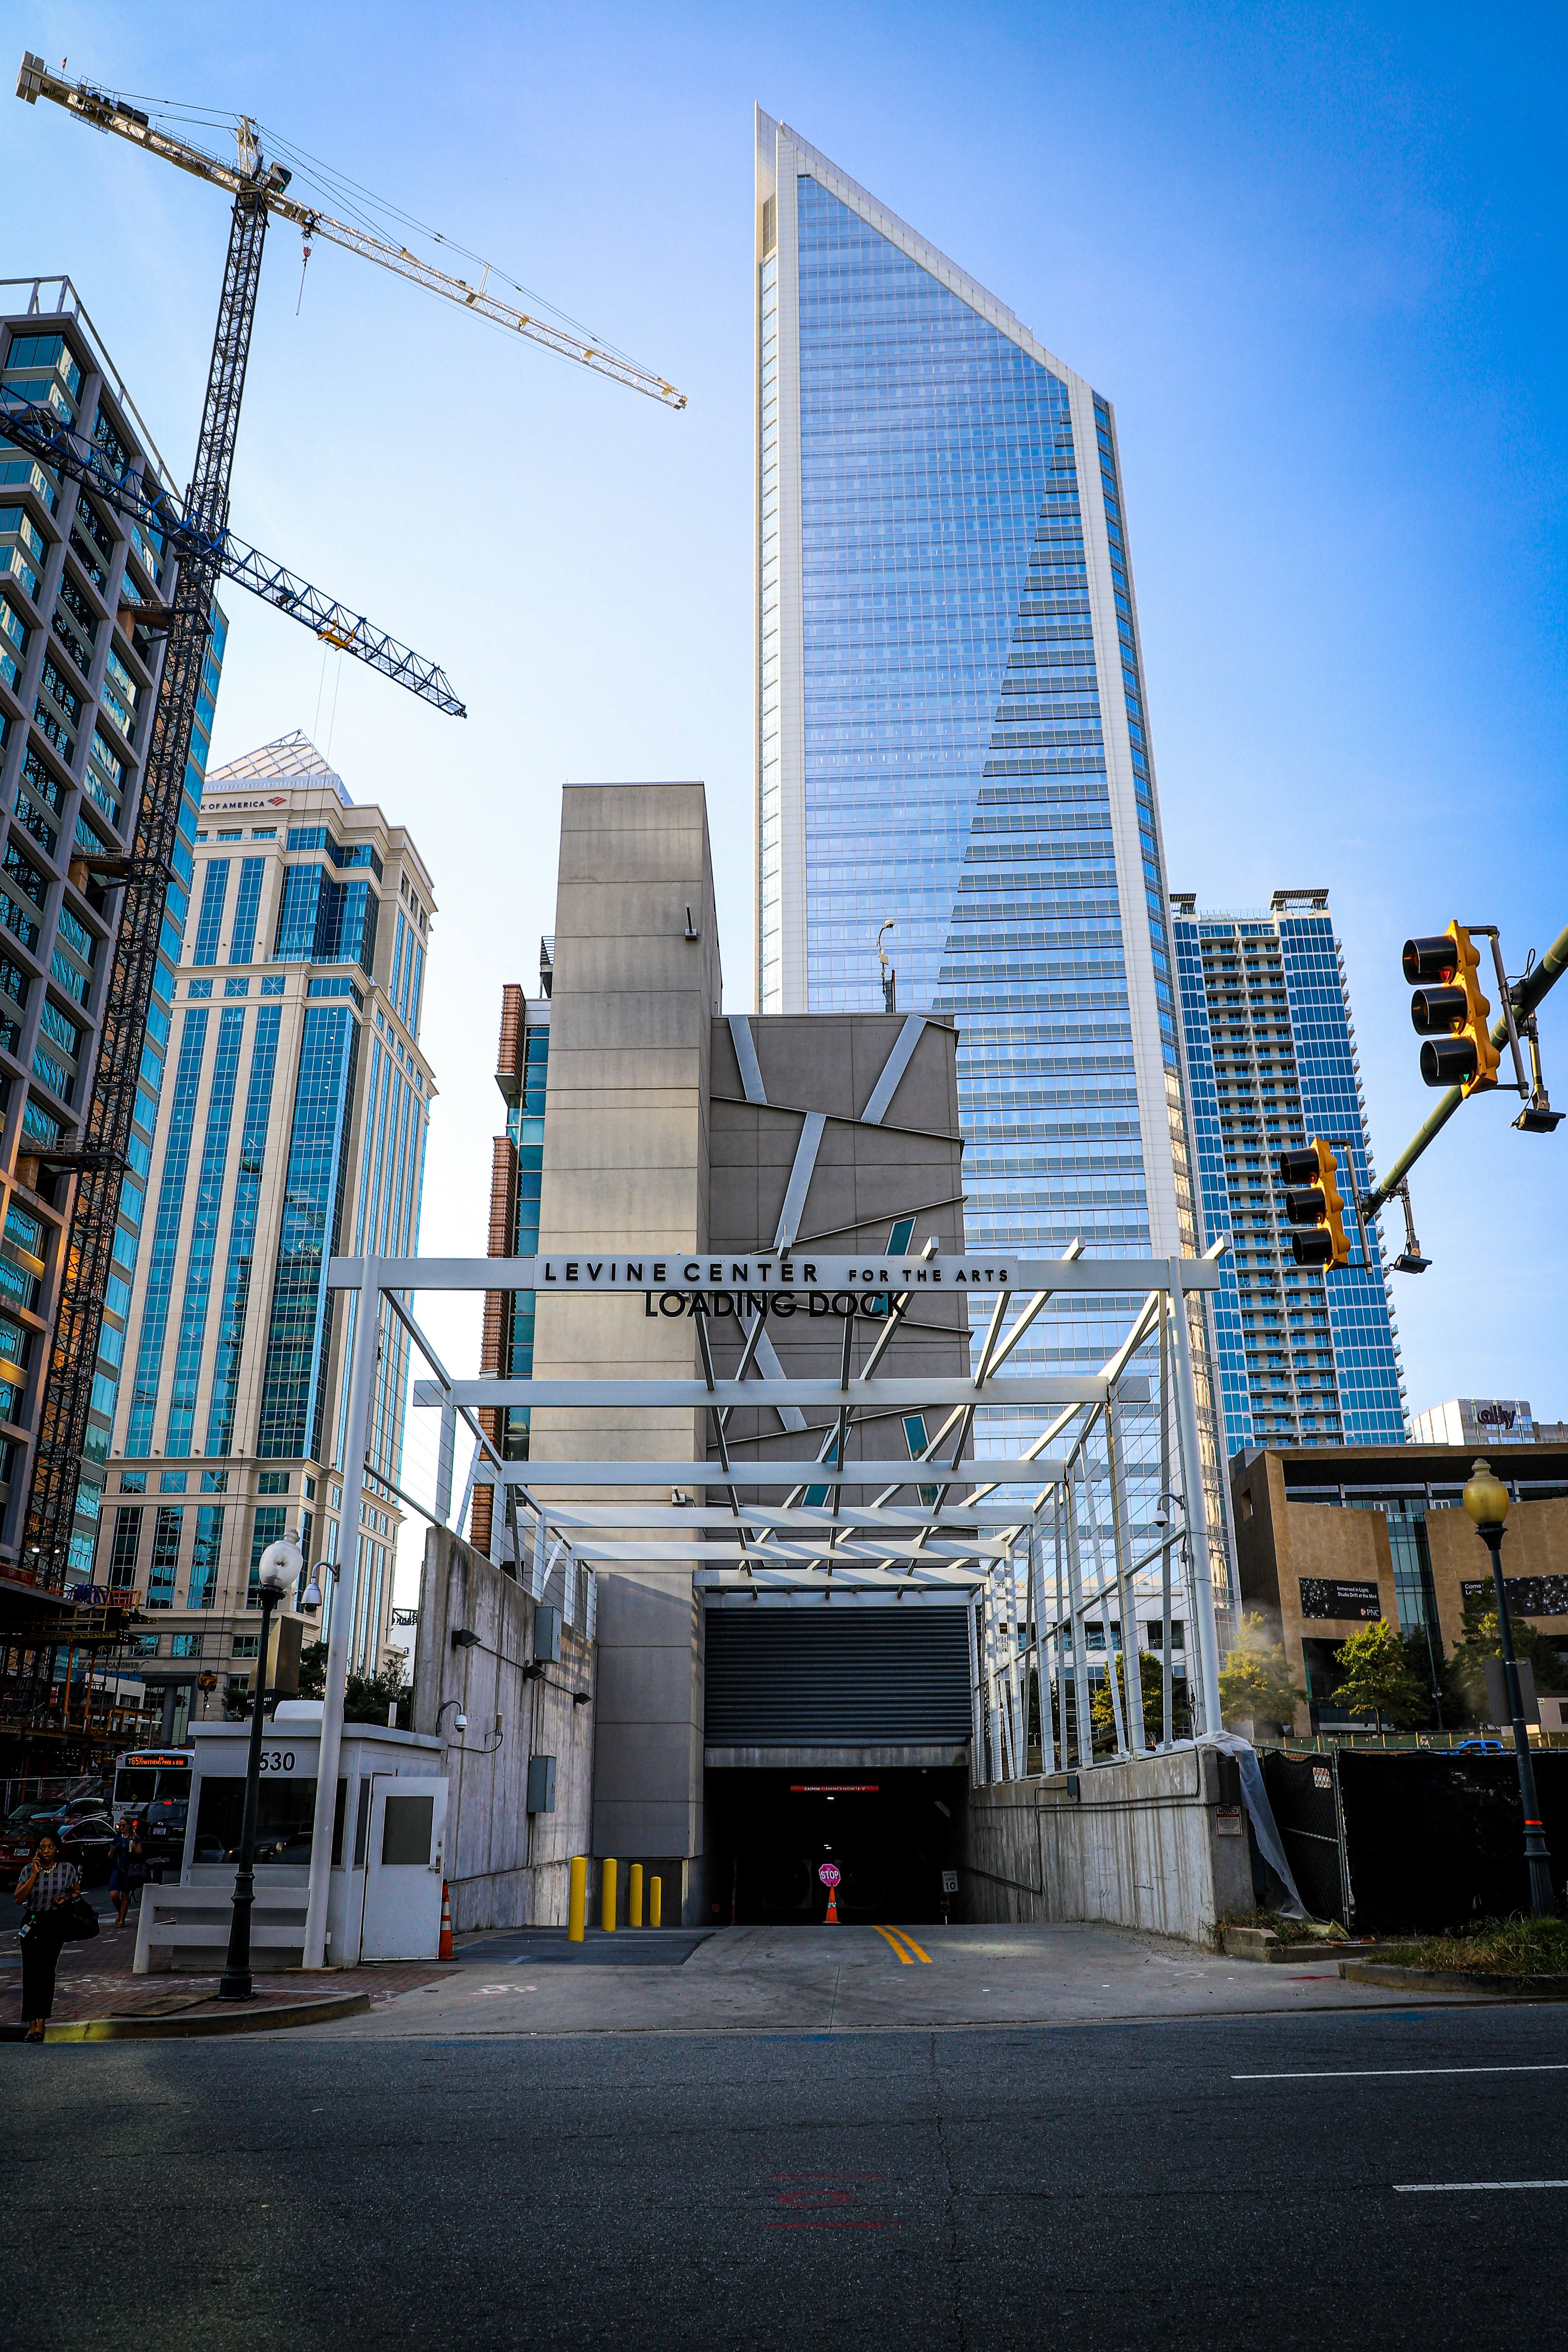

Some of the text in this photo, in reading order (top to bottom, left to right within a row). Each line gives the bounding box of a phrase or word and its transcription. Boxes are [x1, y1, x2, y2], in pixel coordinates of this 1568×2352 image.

[545, 1263, 1008, 1282] LEVINE CENTER FOR THE ARTS
[644, 1291, 906, 1318] LOADING DOCK
[1478, 1405, 1516, 1430] ally
[260, 1751, 295, 1772] 530
[821, 1870, 839, 1879] STOP
[946, 1882, 956, 1890] 10
